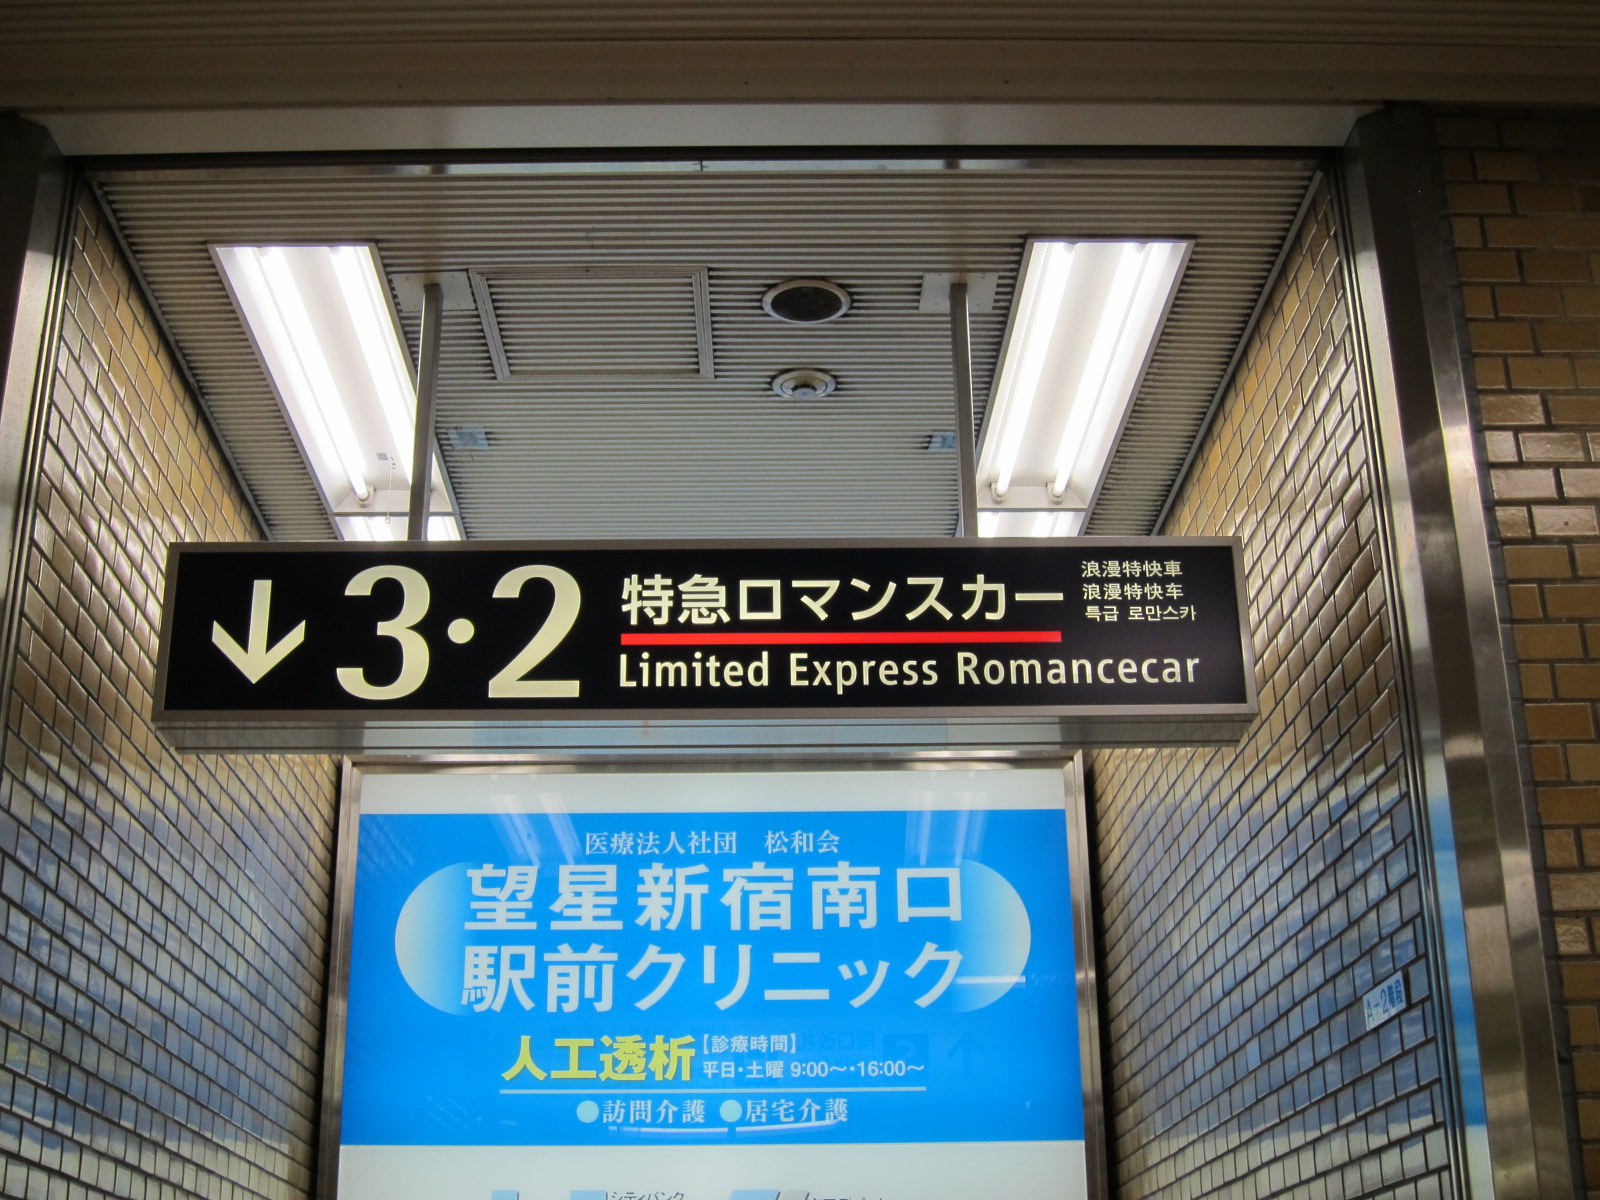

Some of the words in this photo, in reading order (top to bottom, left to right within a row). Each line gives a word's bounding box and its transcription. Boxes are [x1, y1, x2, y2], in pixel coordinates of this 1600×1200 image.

[1081, 560, 1183, 578] 浪漫特快車
[621, 573, 1064, 626] 特急ロマンスカー
[1082, 582, 1184, 601] 浪漫特快车
[1085, 605, 1120, 622] 특급
[1128, 604, 1197, 622] 로만스카
[619, 651, 769, 688] Limited
[790, 652, 939, 695] Express
[957, 651, 1200, 685] Romancecar
[585, 831, 737, 855] 医療法人社団
[764, 830, 840, 854] 松和会
[464, 860, 962, 931] 望星新宿南口
[461, 942, 964, 1012] 駅前クリニック
[703, 1033, 796, 1054] 【診療時間】
[501, 1035, 696, 1082] 人工透析
[602, 1100, 706, 1124] 訪問介護
[745, 1099, 849, 1123] 居宅介護
